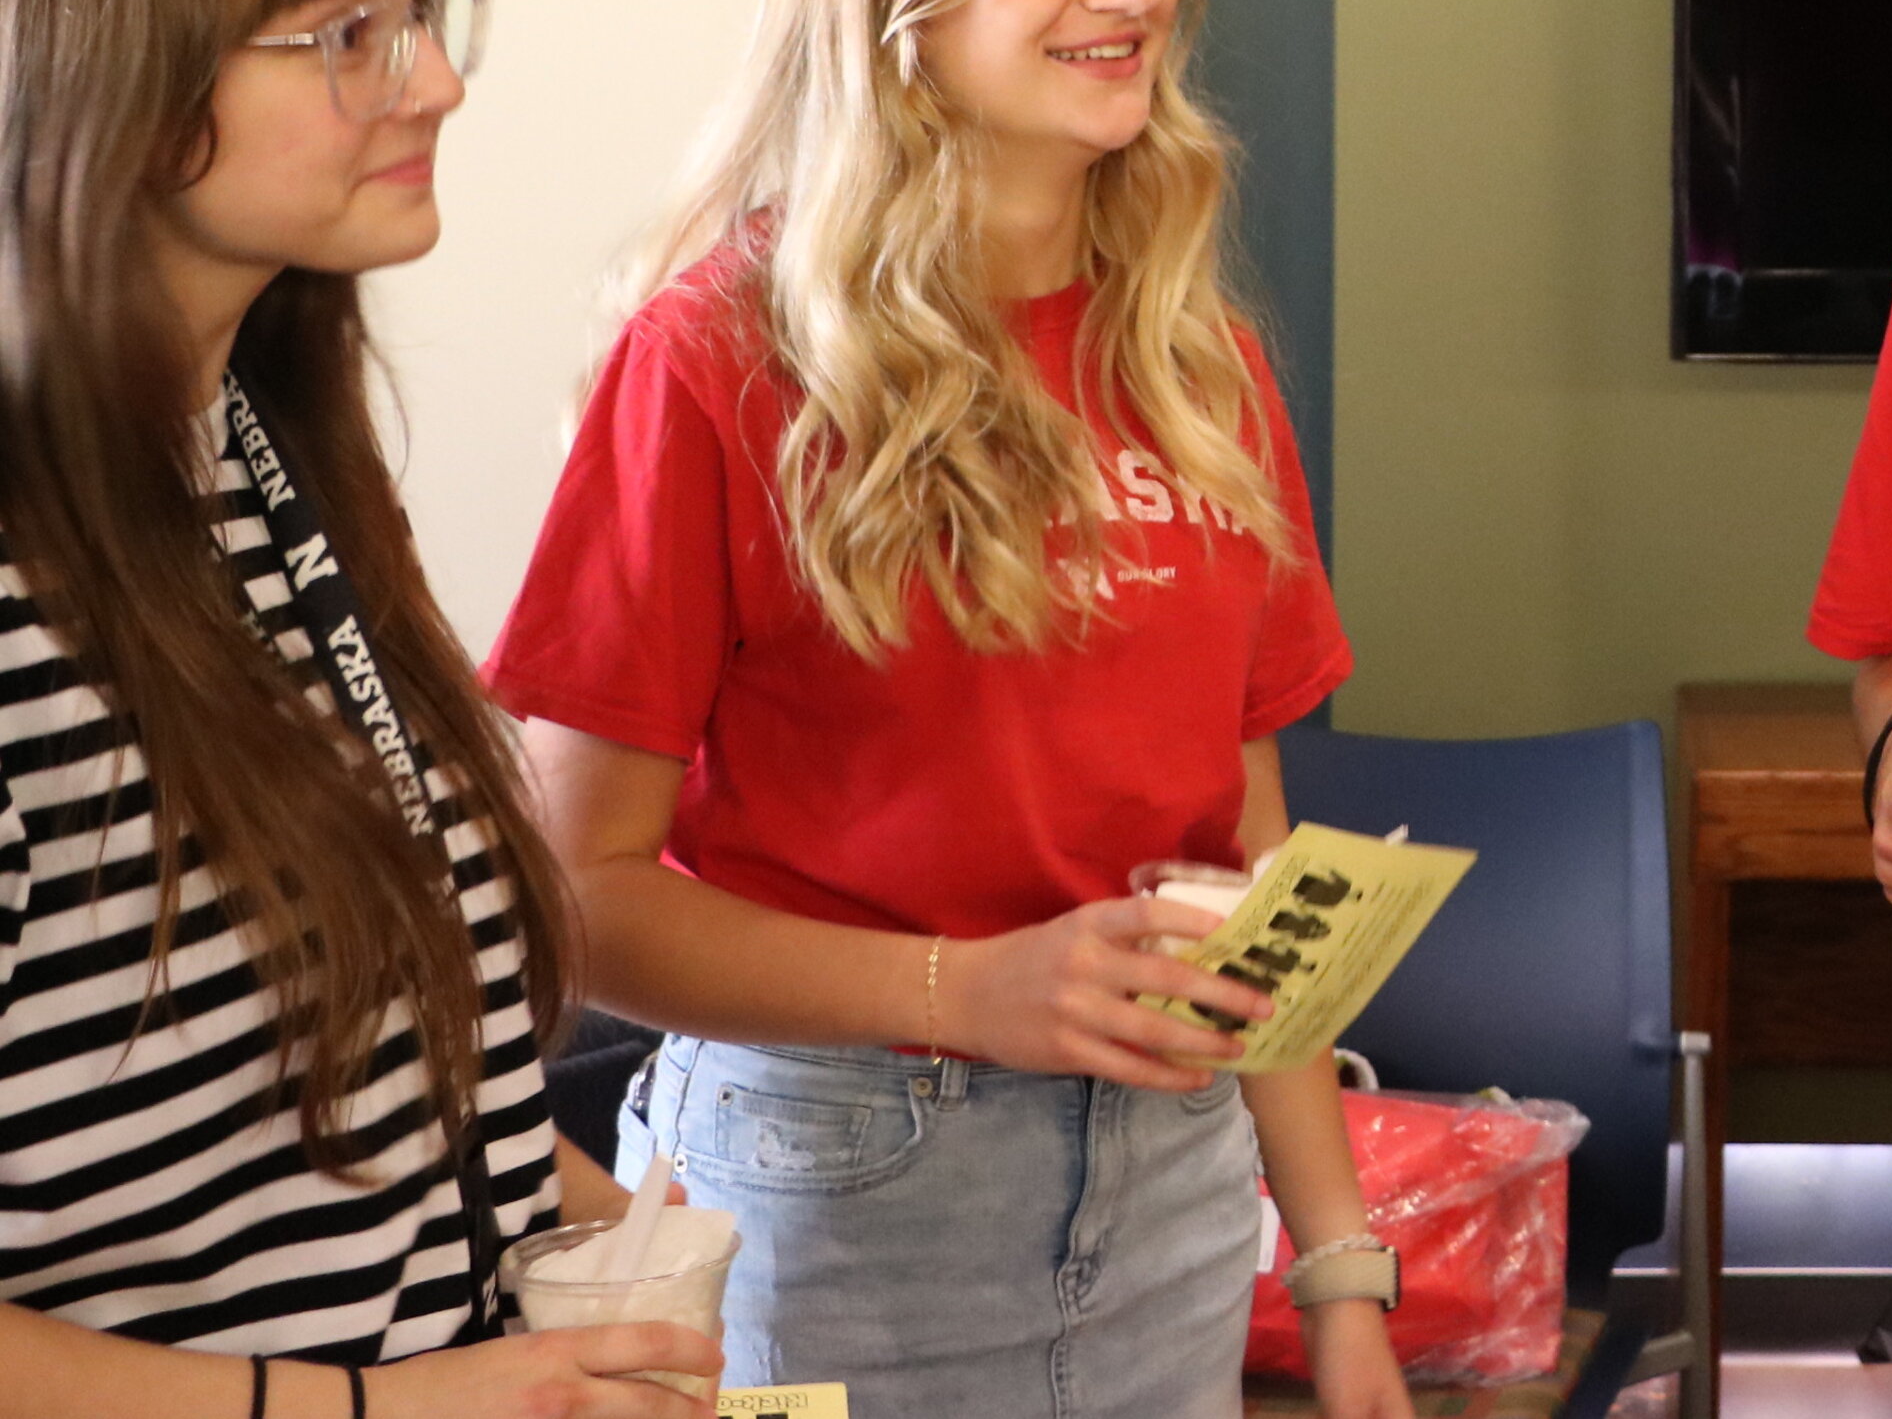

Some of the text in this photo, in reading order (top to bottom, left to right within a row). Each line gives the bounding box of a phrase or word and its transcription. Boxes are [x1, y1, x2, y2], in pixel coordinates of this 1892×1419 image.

[222, 363, 296, 513] NEBRA
[284, 533, 339, 591] N
[327, 615, 434, 836] NEBRASKA
[716, 1392, 808, 1412] Kick-o
